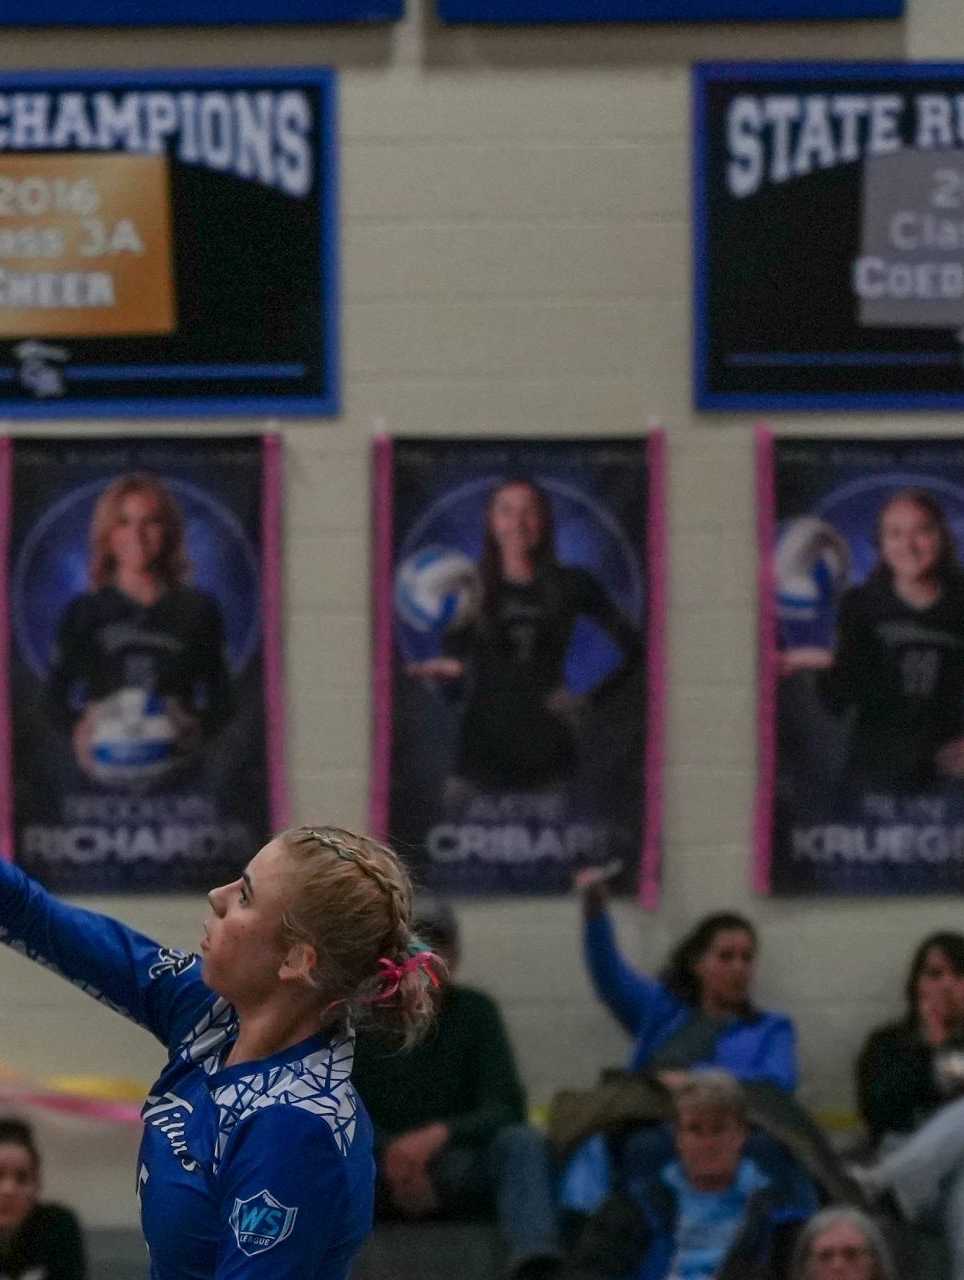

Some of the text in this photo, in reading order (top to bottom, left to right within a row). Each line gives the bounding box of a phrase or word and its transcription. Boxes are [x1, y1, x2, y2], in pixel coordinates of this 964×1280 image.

[726, 93, 964, 198] STATE R
[77, 217, 146, 258] 3A
[241, 1205, 283, 1236] WS
[239, 1234, 272, 1247] LEAGUE
